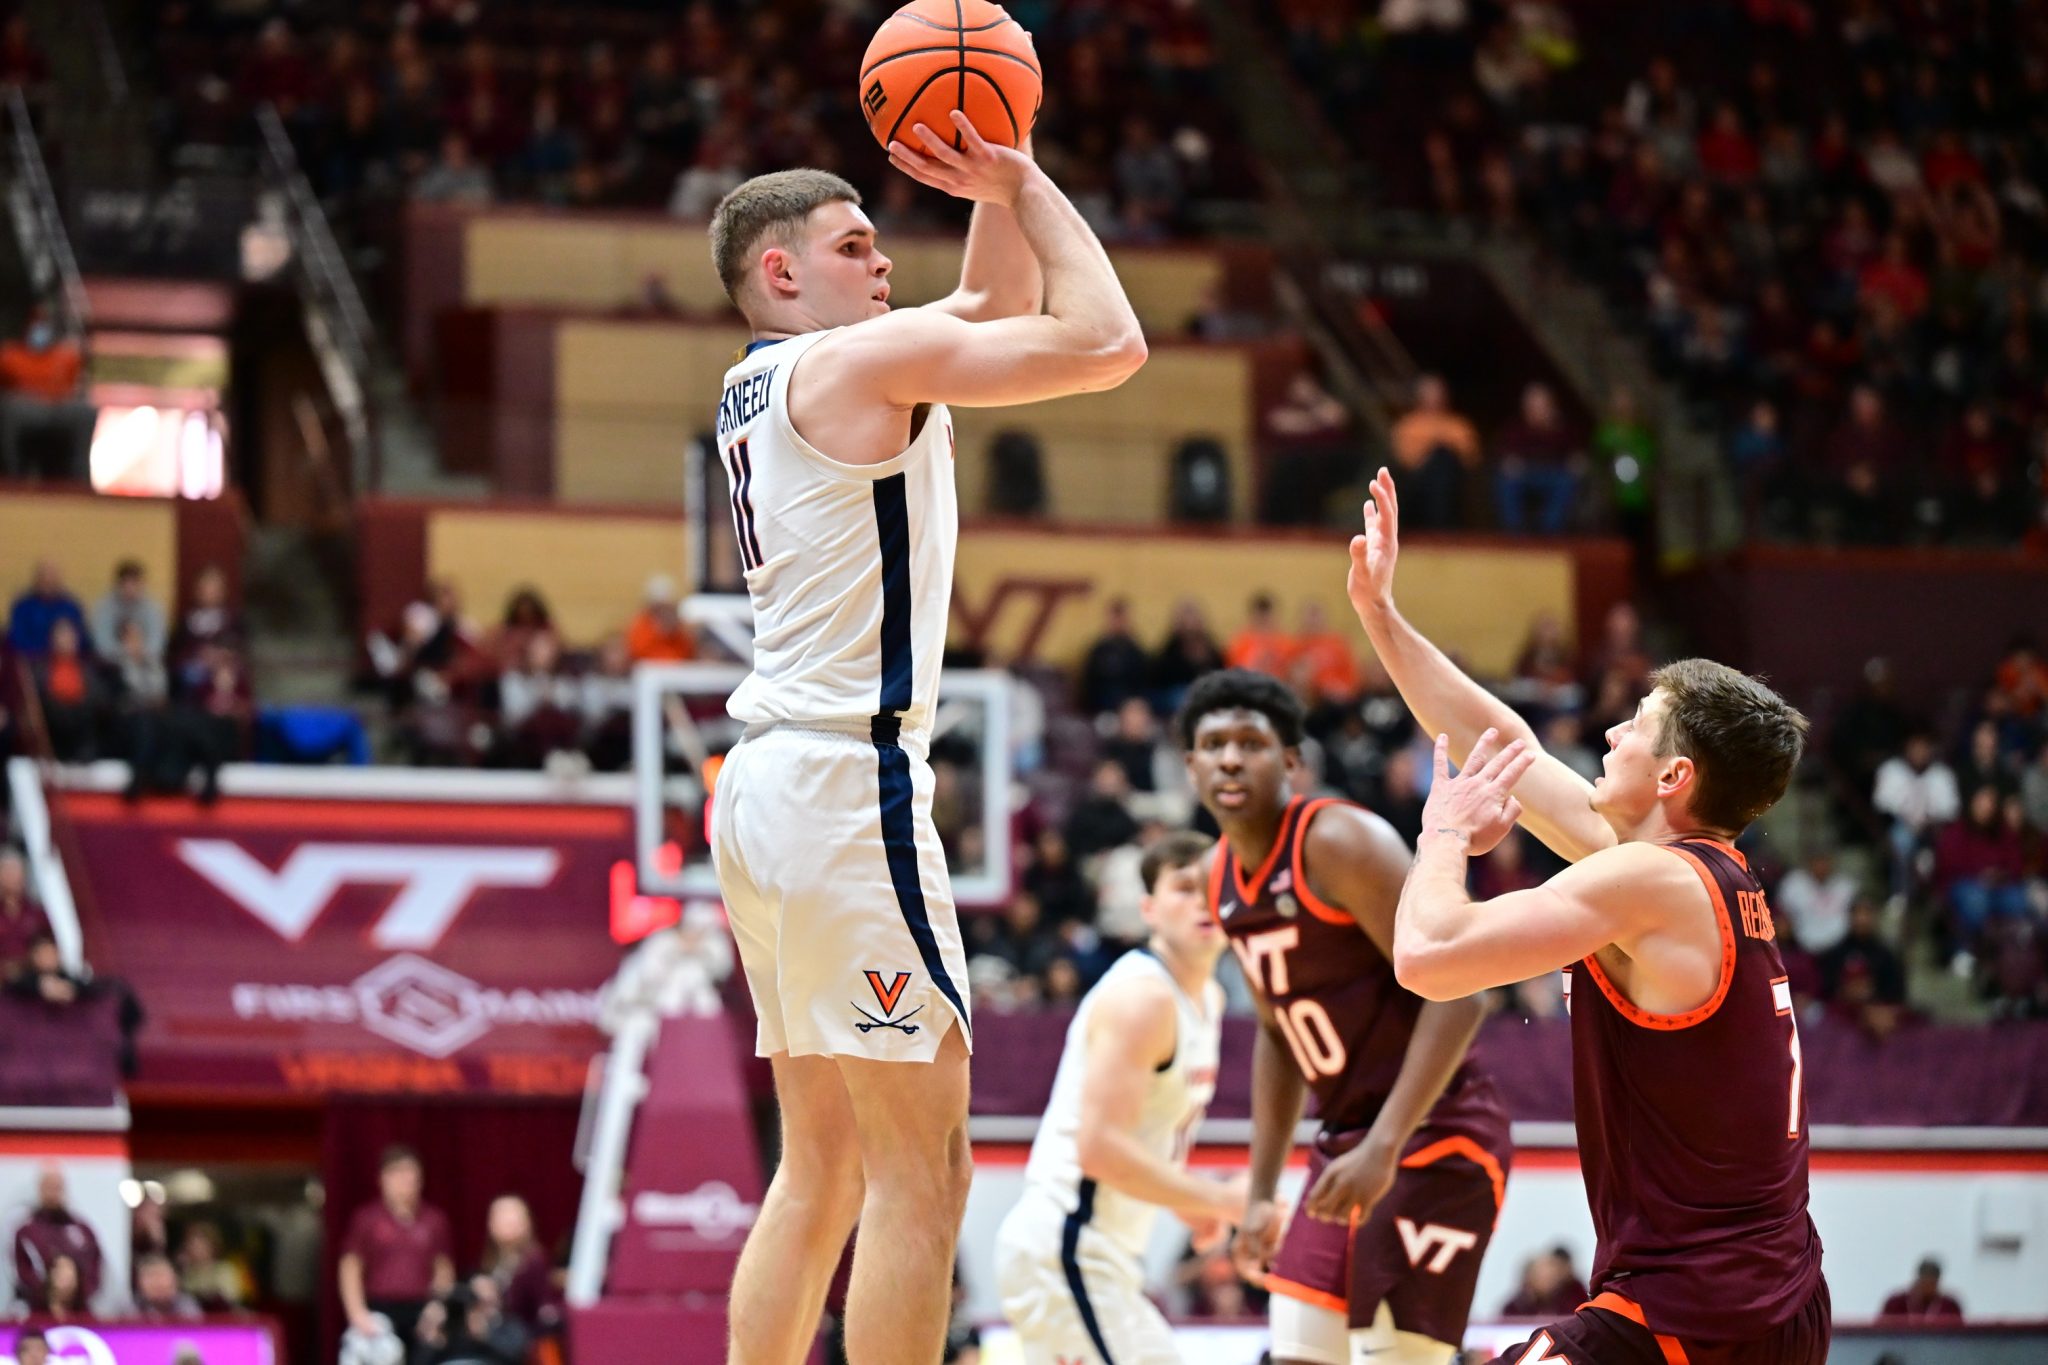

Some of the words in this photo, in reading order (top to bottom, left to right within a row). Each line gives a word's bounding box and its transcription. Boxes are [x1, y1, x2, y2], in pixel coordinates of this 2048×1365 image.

[727, 437, 764, 571] 11
[174, 837, 563, 951] VT
[863, 969, 912, 1018] V
[1273, 998, 1348, 1082] 10
[1771, 975, 1801, 1138] 7
[1395, 1216, 1478, 1274] VT
